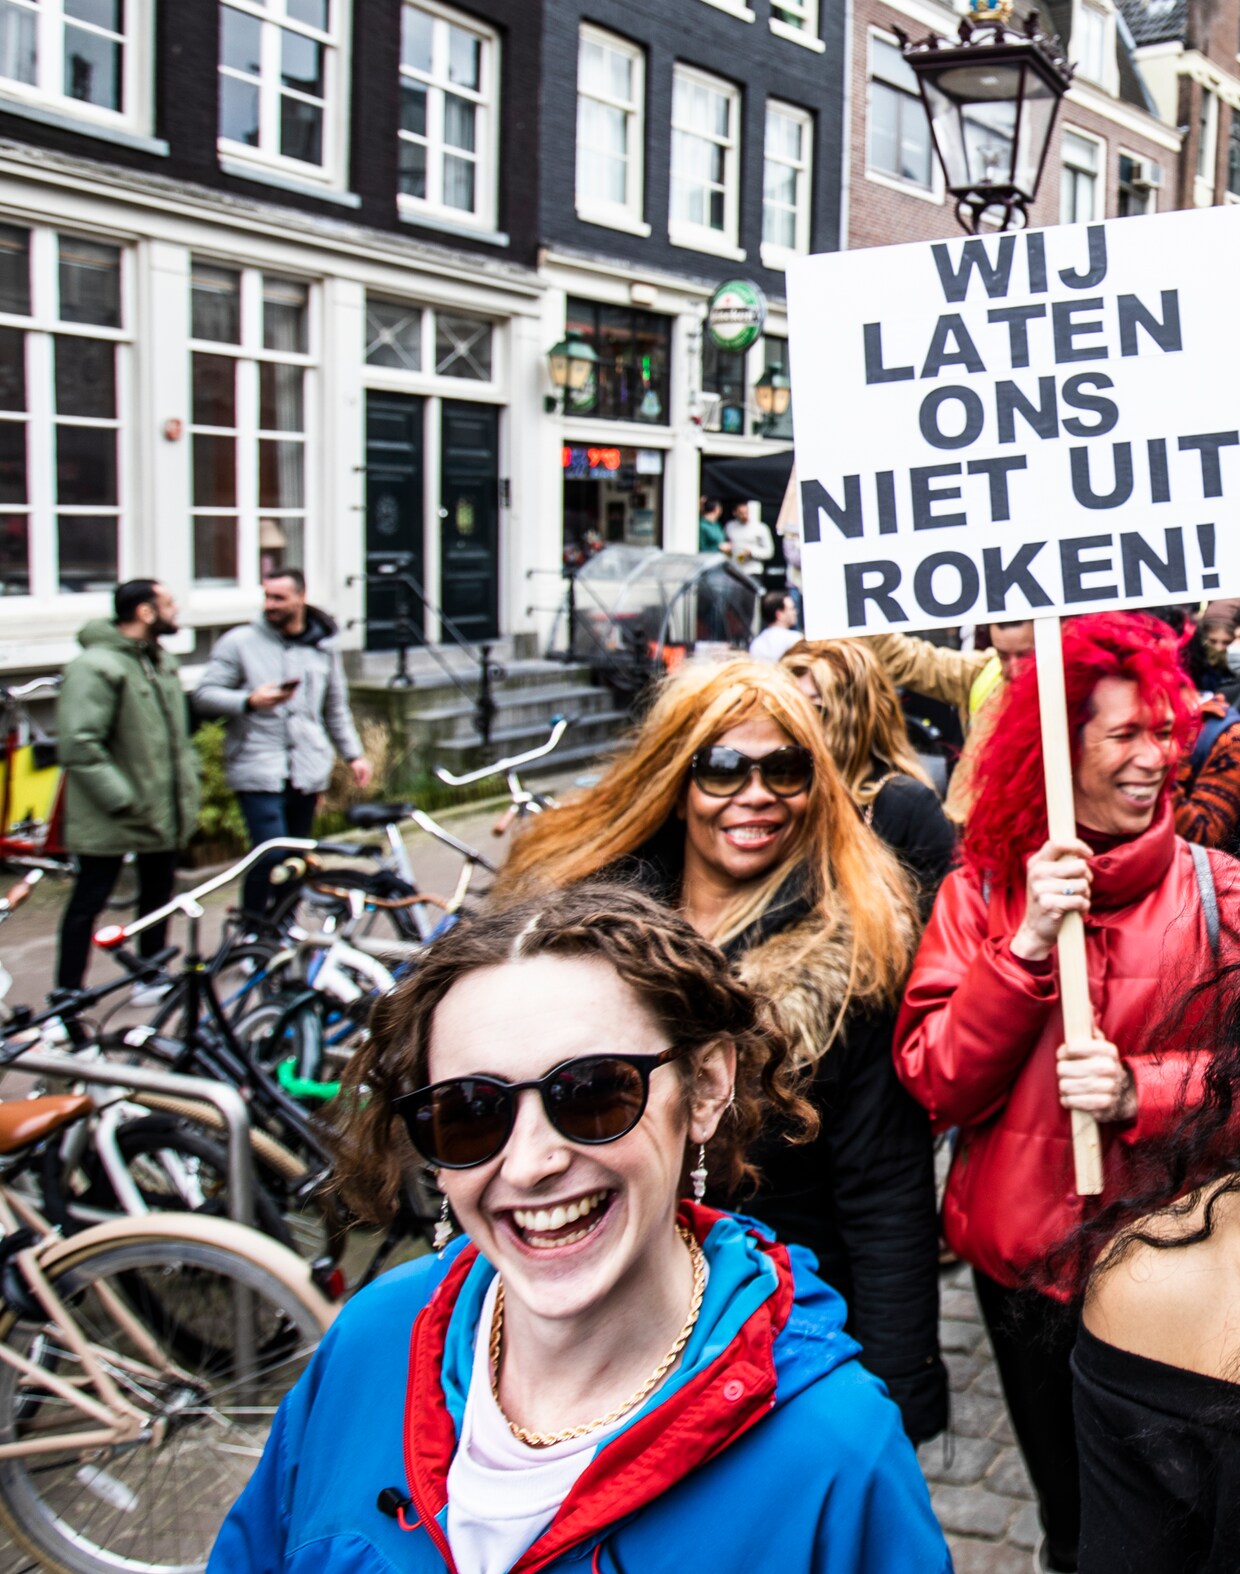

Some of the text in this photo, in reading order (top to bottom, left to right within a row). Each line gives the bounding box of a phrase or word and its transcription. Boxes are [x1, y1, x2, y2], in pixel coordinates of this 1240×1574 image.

[931, 224, 1108, 302] WIJ
[863, 289, 1183, 385] LATEN
[918, 372, 1120, 450] ONS
[800, 430, 1240, 543] NIET UIT
[843, 523, 1220, 627] ROKEN!
